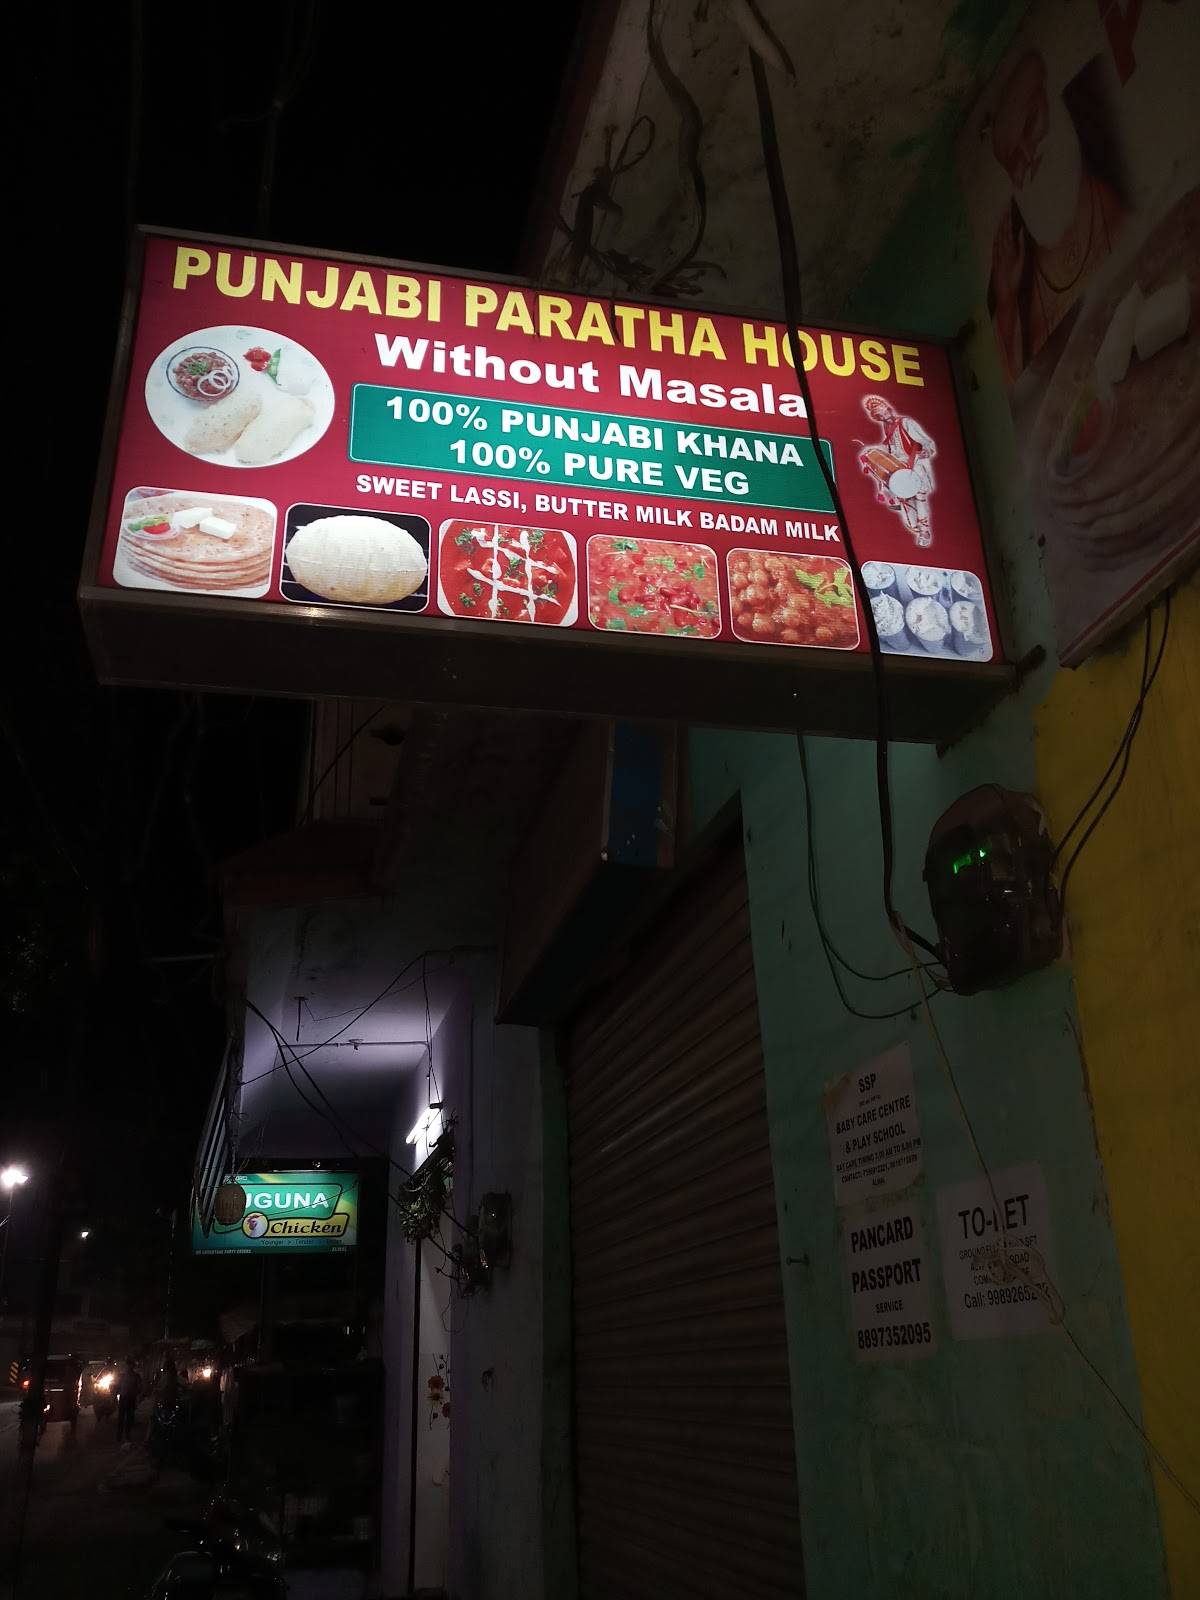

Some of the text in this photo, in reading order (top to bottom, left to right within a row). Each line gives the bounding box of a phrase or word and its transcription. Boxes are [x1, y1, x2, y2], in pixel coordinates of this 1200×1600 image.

[173, 246, 926, 387] PUNJABI PARATHA HOUSE
[374, 333, 809, 419] Without Masala
[386, 396, 804, 467] 100% PUNJABI KHANA
[450, 440, 750, 496] 100% PURE VEG
[356, 474, 841, 542] SWEET LASSI, BUTTER MILK BADAM MILK
[858, 1073, 877, 1093] SSP
[836, 1118, 855, 1135] BABY
[857, 1109, 877, 1127] CARE
[878, 1095, 911, 1118] CENTRE
[845, 1122, 906, 1154] & PLAY SCHOOL
[271, 1222, 342, 1235] Chicken
[851, 1216, 913, 1253] PANCARD
[852, 1258, 921, 1293] PASSPORT
[876, 1300, 903, 1313] SERVICE
[964, 1292, 986, 1309] Call:
[857, 1322, 931, 1349] 8897352095
